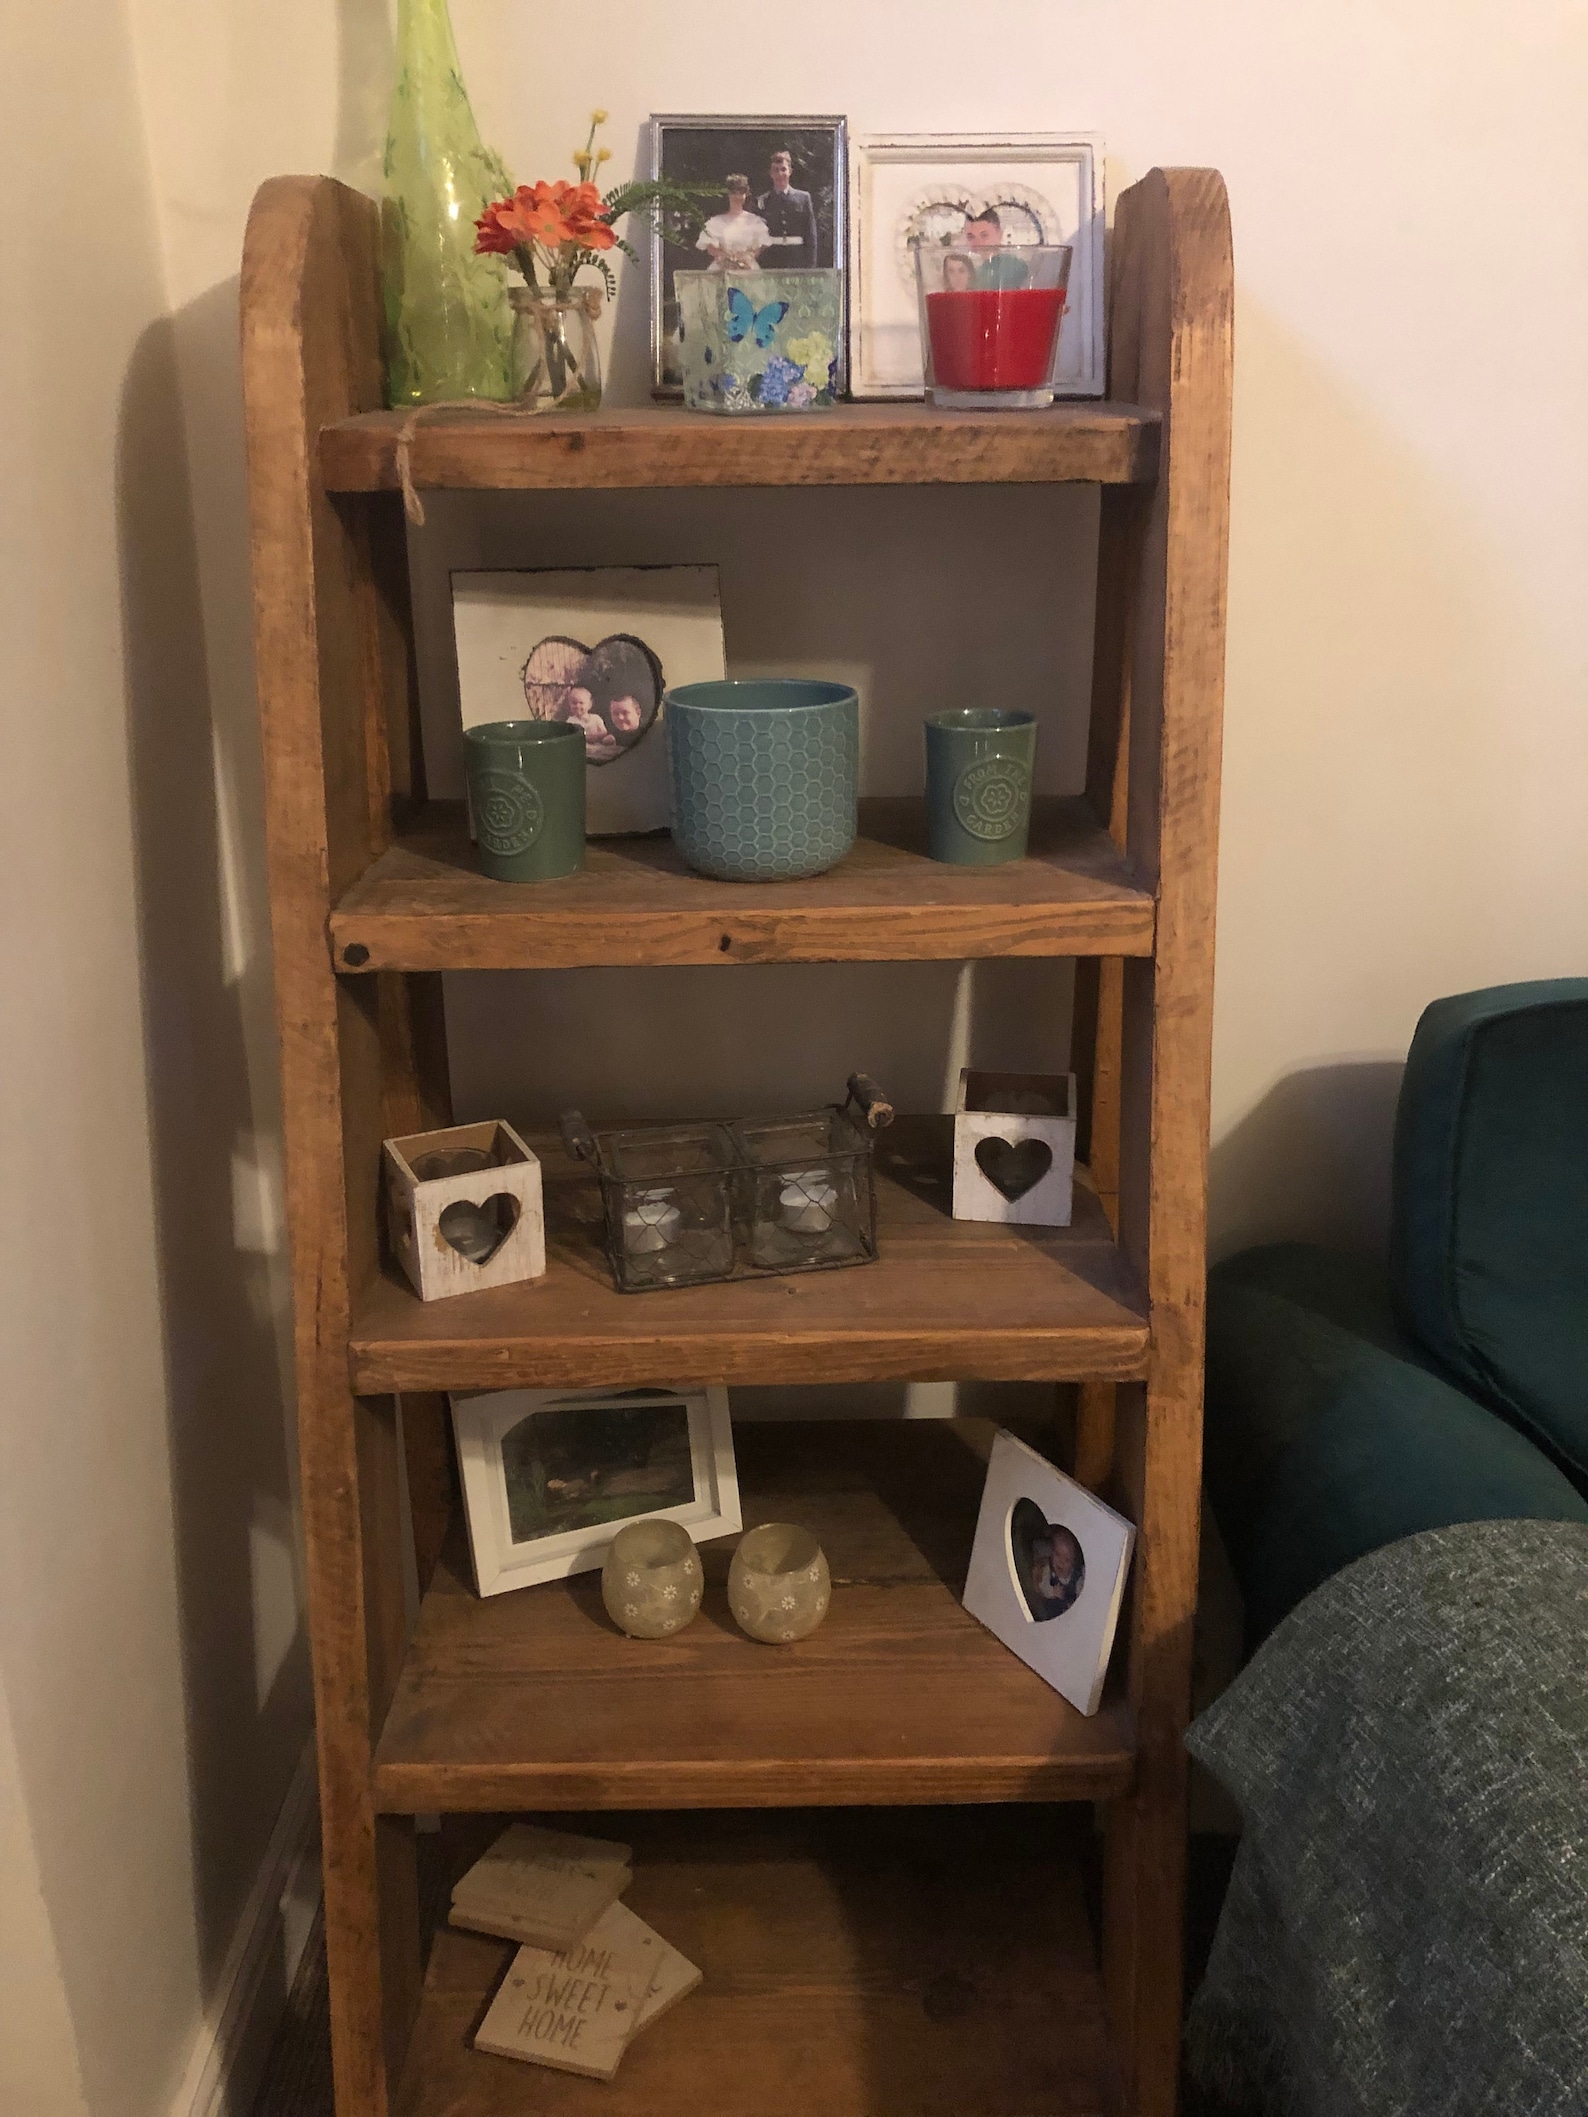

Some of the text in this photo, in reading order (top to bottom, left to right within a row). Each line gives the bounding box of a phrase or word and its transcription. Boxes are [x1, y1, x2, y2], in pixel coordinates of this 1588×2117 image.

[966, 811, 1020, 834] GARDEN
[551, 1945, 617, 1979] HOME
[527, 1974, 612, 2012] SWEET
[517, 2006, 587, 2048] HOME
